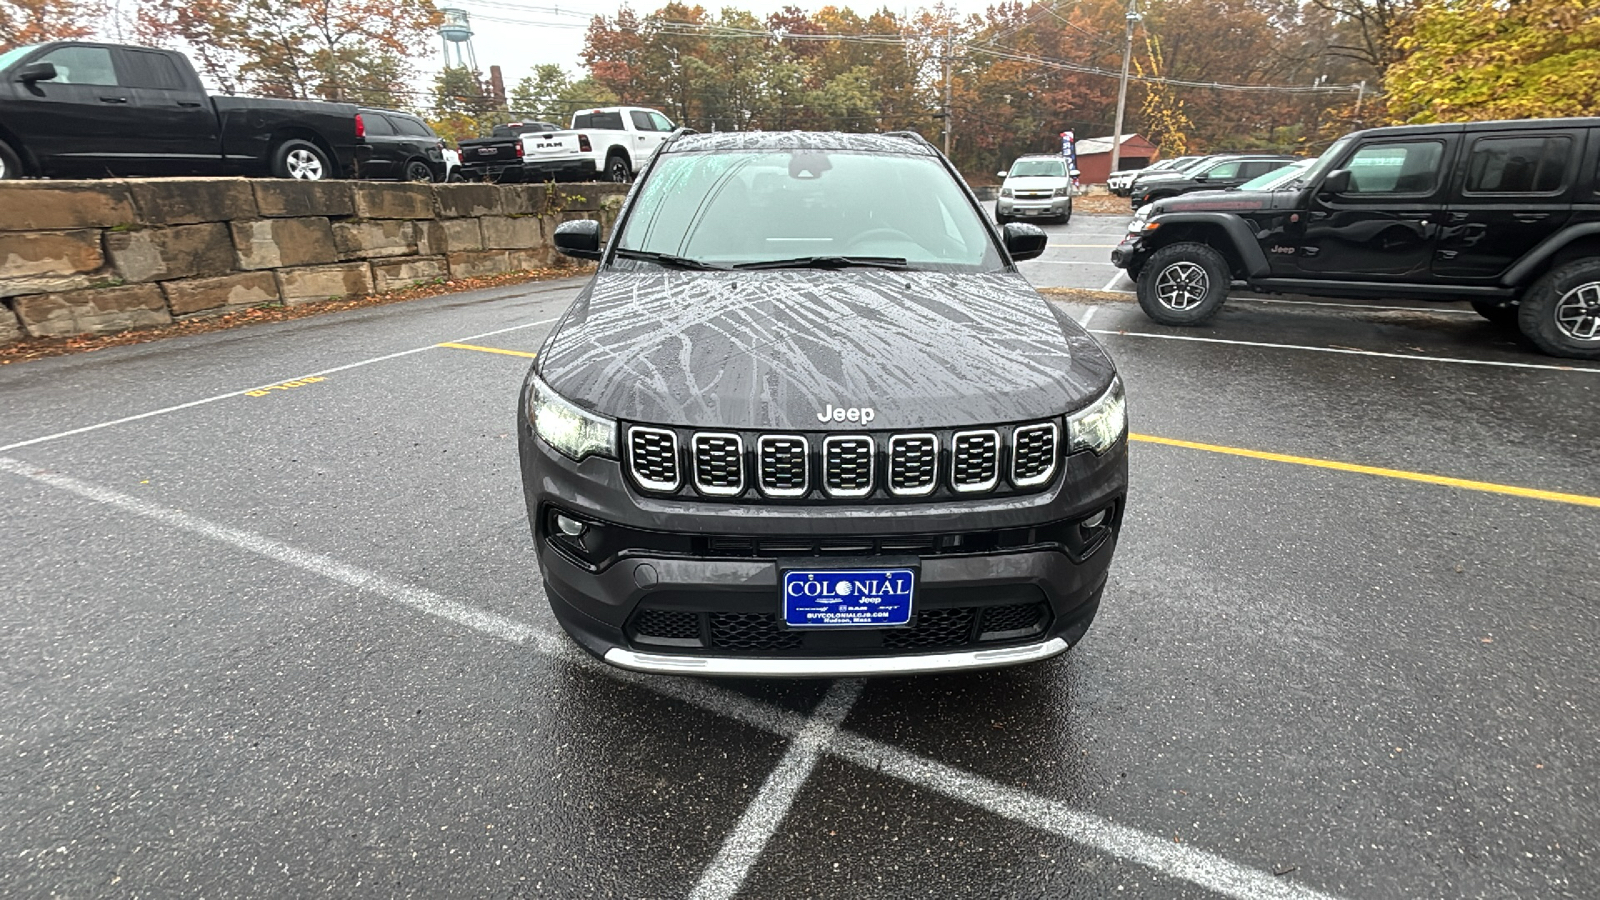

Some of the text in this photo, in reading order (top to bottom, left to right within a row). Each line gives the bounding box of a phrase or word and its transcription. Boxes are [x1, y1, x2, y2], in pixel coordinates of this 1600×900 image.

[1271, 245, 1295, 254] Jeep
[817, 404, 875, 425] Jeep
[787, 580, 910, 597] COLONIAL
[859, 596, 881, 604] Jeep
